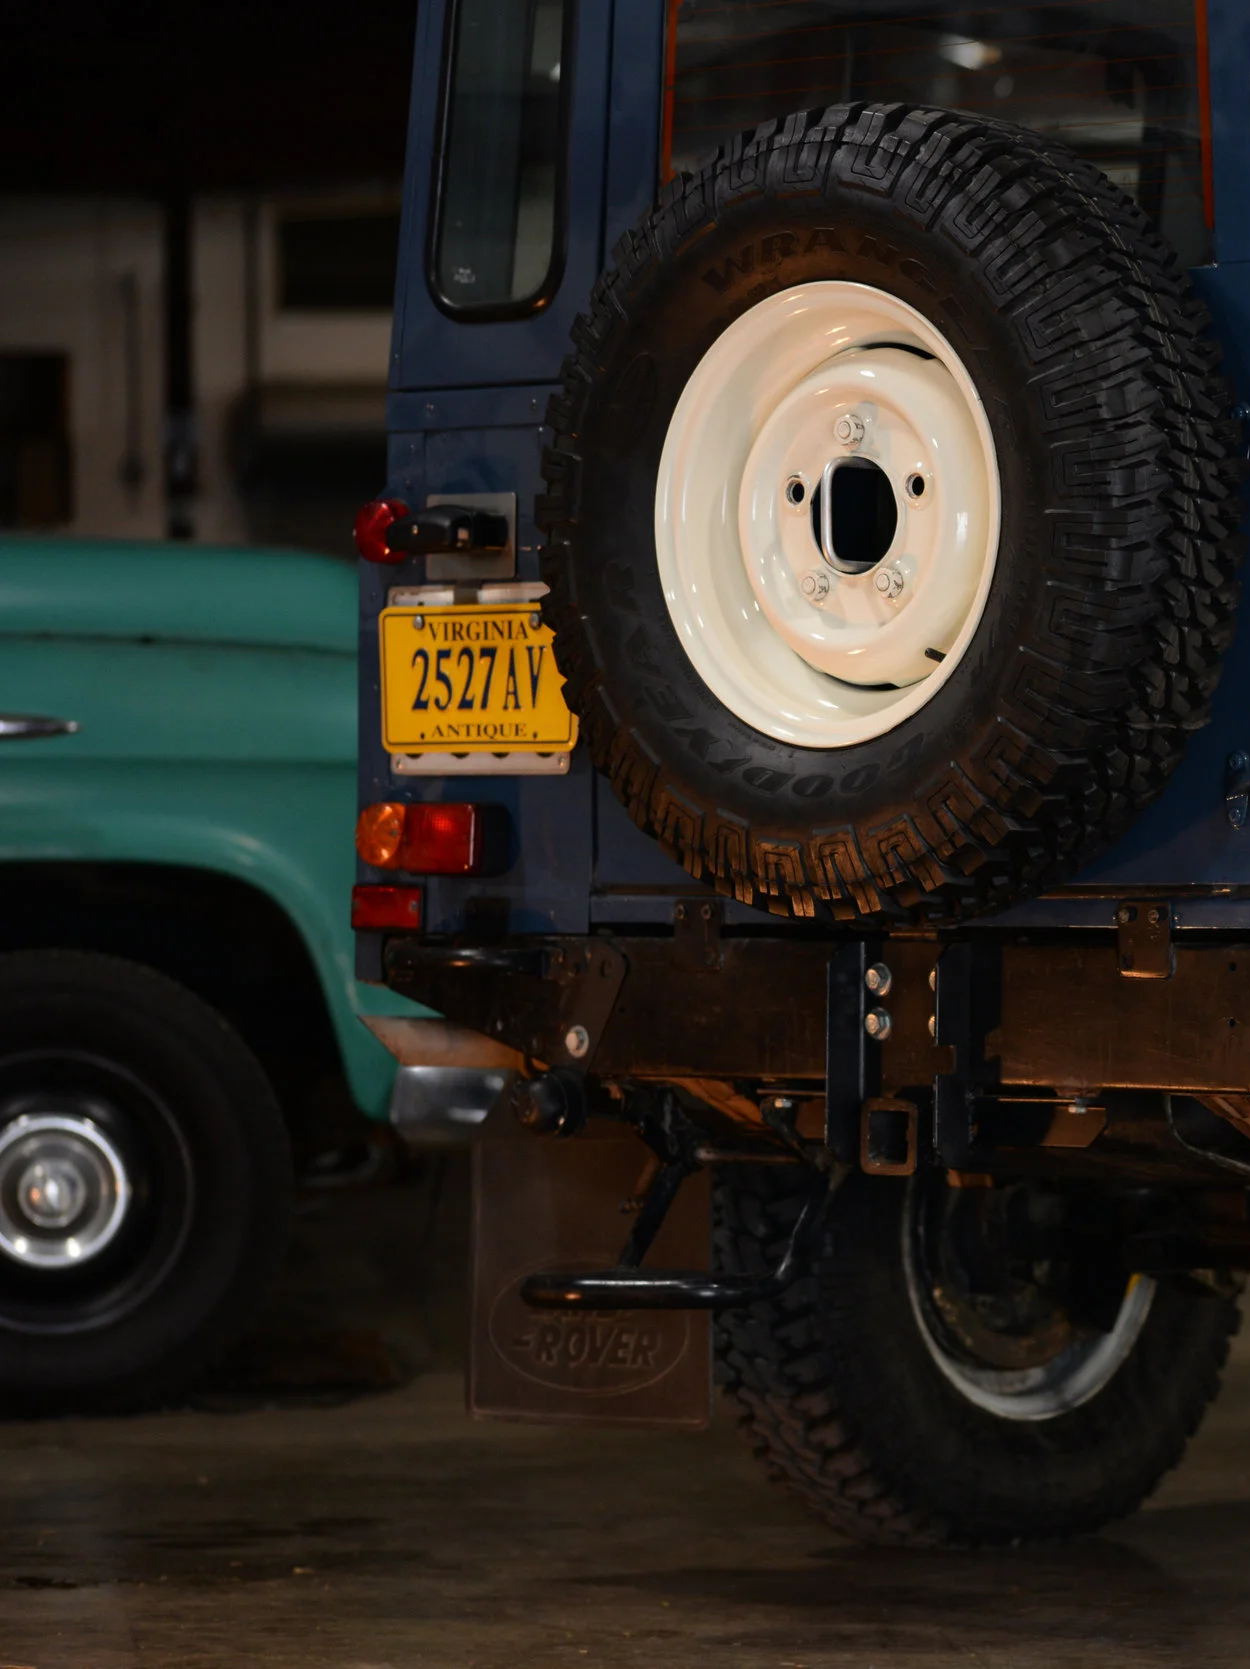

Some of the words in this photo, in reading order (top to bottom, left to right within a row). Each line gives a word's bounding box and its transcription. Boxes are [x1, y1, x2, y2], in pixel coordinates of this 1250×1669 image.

[427, 620, 529, 642] VIRGINIA
[431, 723, 527, 740] ANTIQUE
[534, 1324, 662, 1368] ROVER
